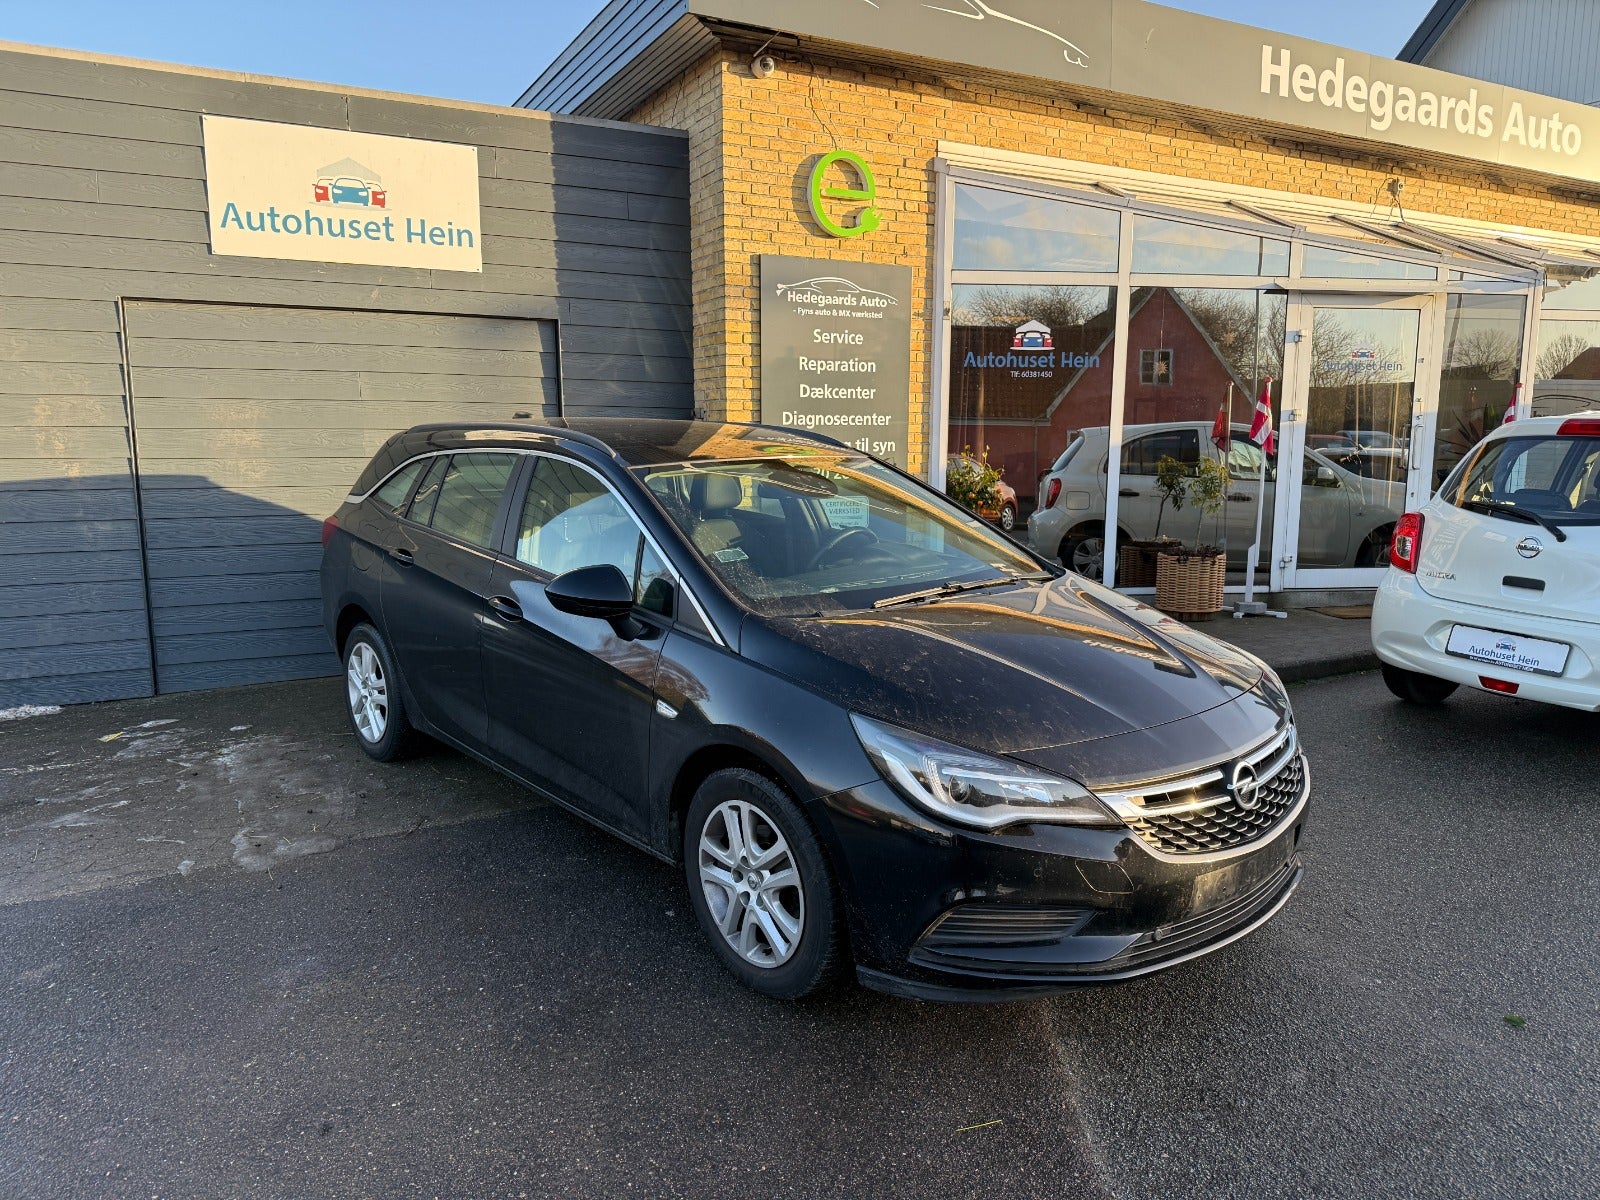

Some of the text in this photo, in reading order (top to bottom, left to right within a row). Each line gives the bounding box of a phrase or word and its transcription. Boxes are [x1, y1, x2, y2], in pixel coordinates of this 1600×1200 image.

[1260, 44, 1582, 156] Hedegaards Auto
[220, 202, 474, 248] Autohuset Hein
[787, 290, 888, 308] Hedegaards Auto
[797, 307, 814, 316] Fyns
[814, 308, 831, 316] auto
[838, 309, 851, 317] MX
[851, 311, 883, 319] værksted
[813, 328, 864, 345] Service
[799, 356, 876, 374] Reparation
[963, 351, 1100, 368] Autohuset Hein
[1379, 361, 1402, 371] Hein
[1021, 370, 1053, 378] 60381450
[800, 383, 876, 400] Dækcenter
[782, 411, 892, 429] Diagnosecenter
[855, 437, 869, 453] til
[872, 441, 896, 456] syn
[1468, 645, 1516, 661] Autohuset
[1518, 654, 1540, 667] Hein
